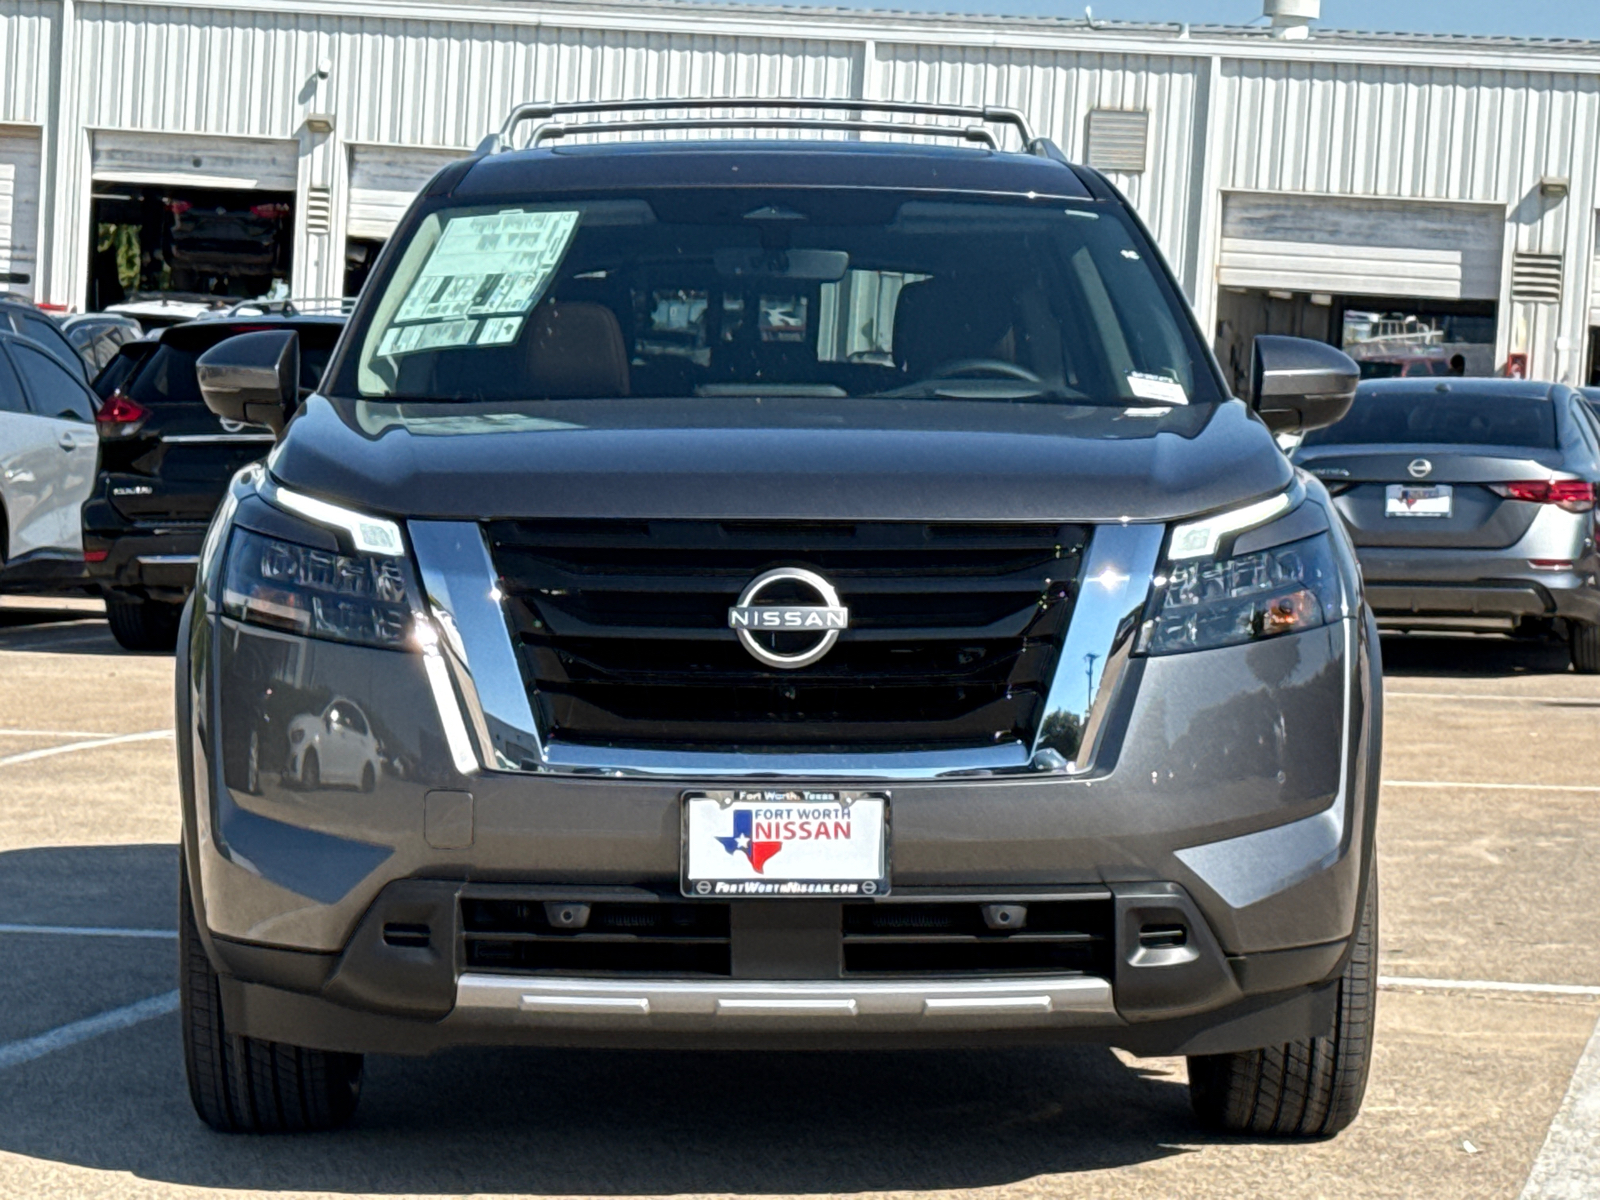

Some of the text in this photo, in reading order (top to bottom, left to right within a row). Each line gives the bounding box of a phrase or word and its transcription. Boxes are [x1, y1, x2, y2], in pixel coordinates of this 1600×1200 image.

[731, 610, 844, 627] NISSAN
[739, 791, 762, 801] Fort
[803, 791, 835, 801] Texas
[755, 808, 851, 820] FORT WORTH
[755, 821, 851, 840] NISSAN
